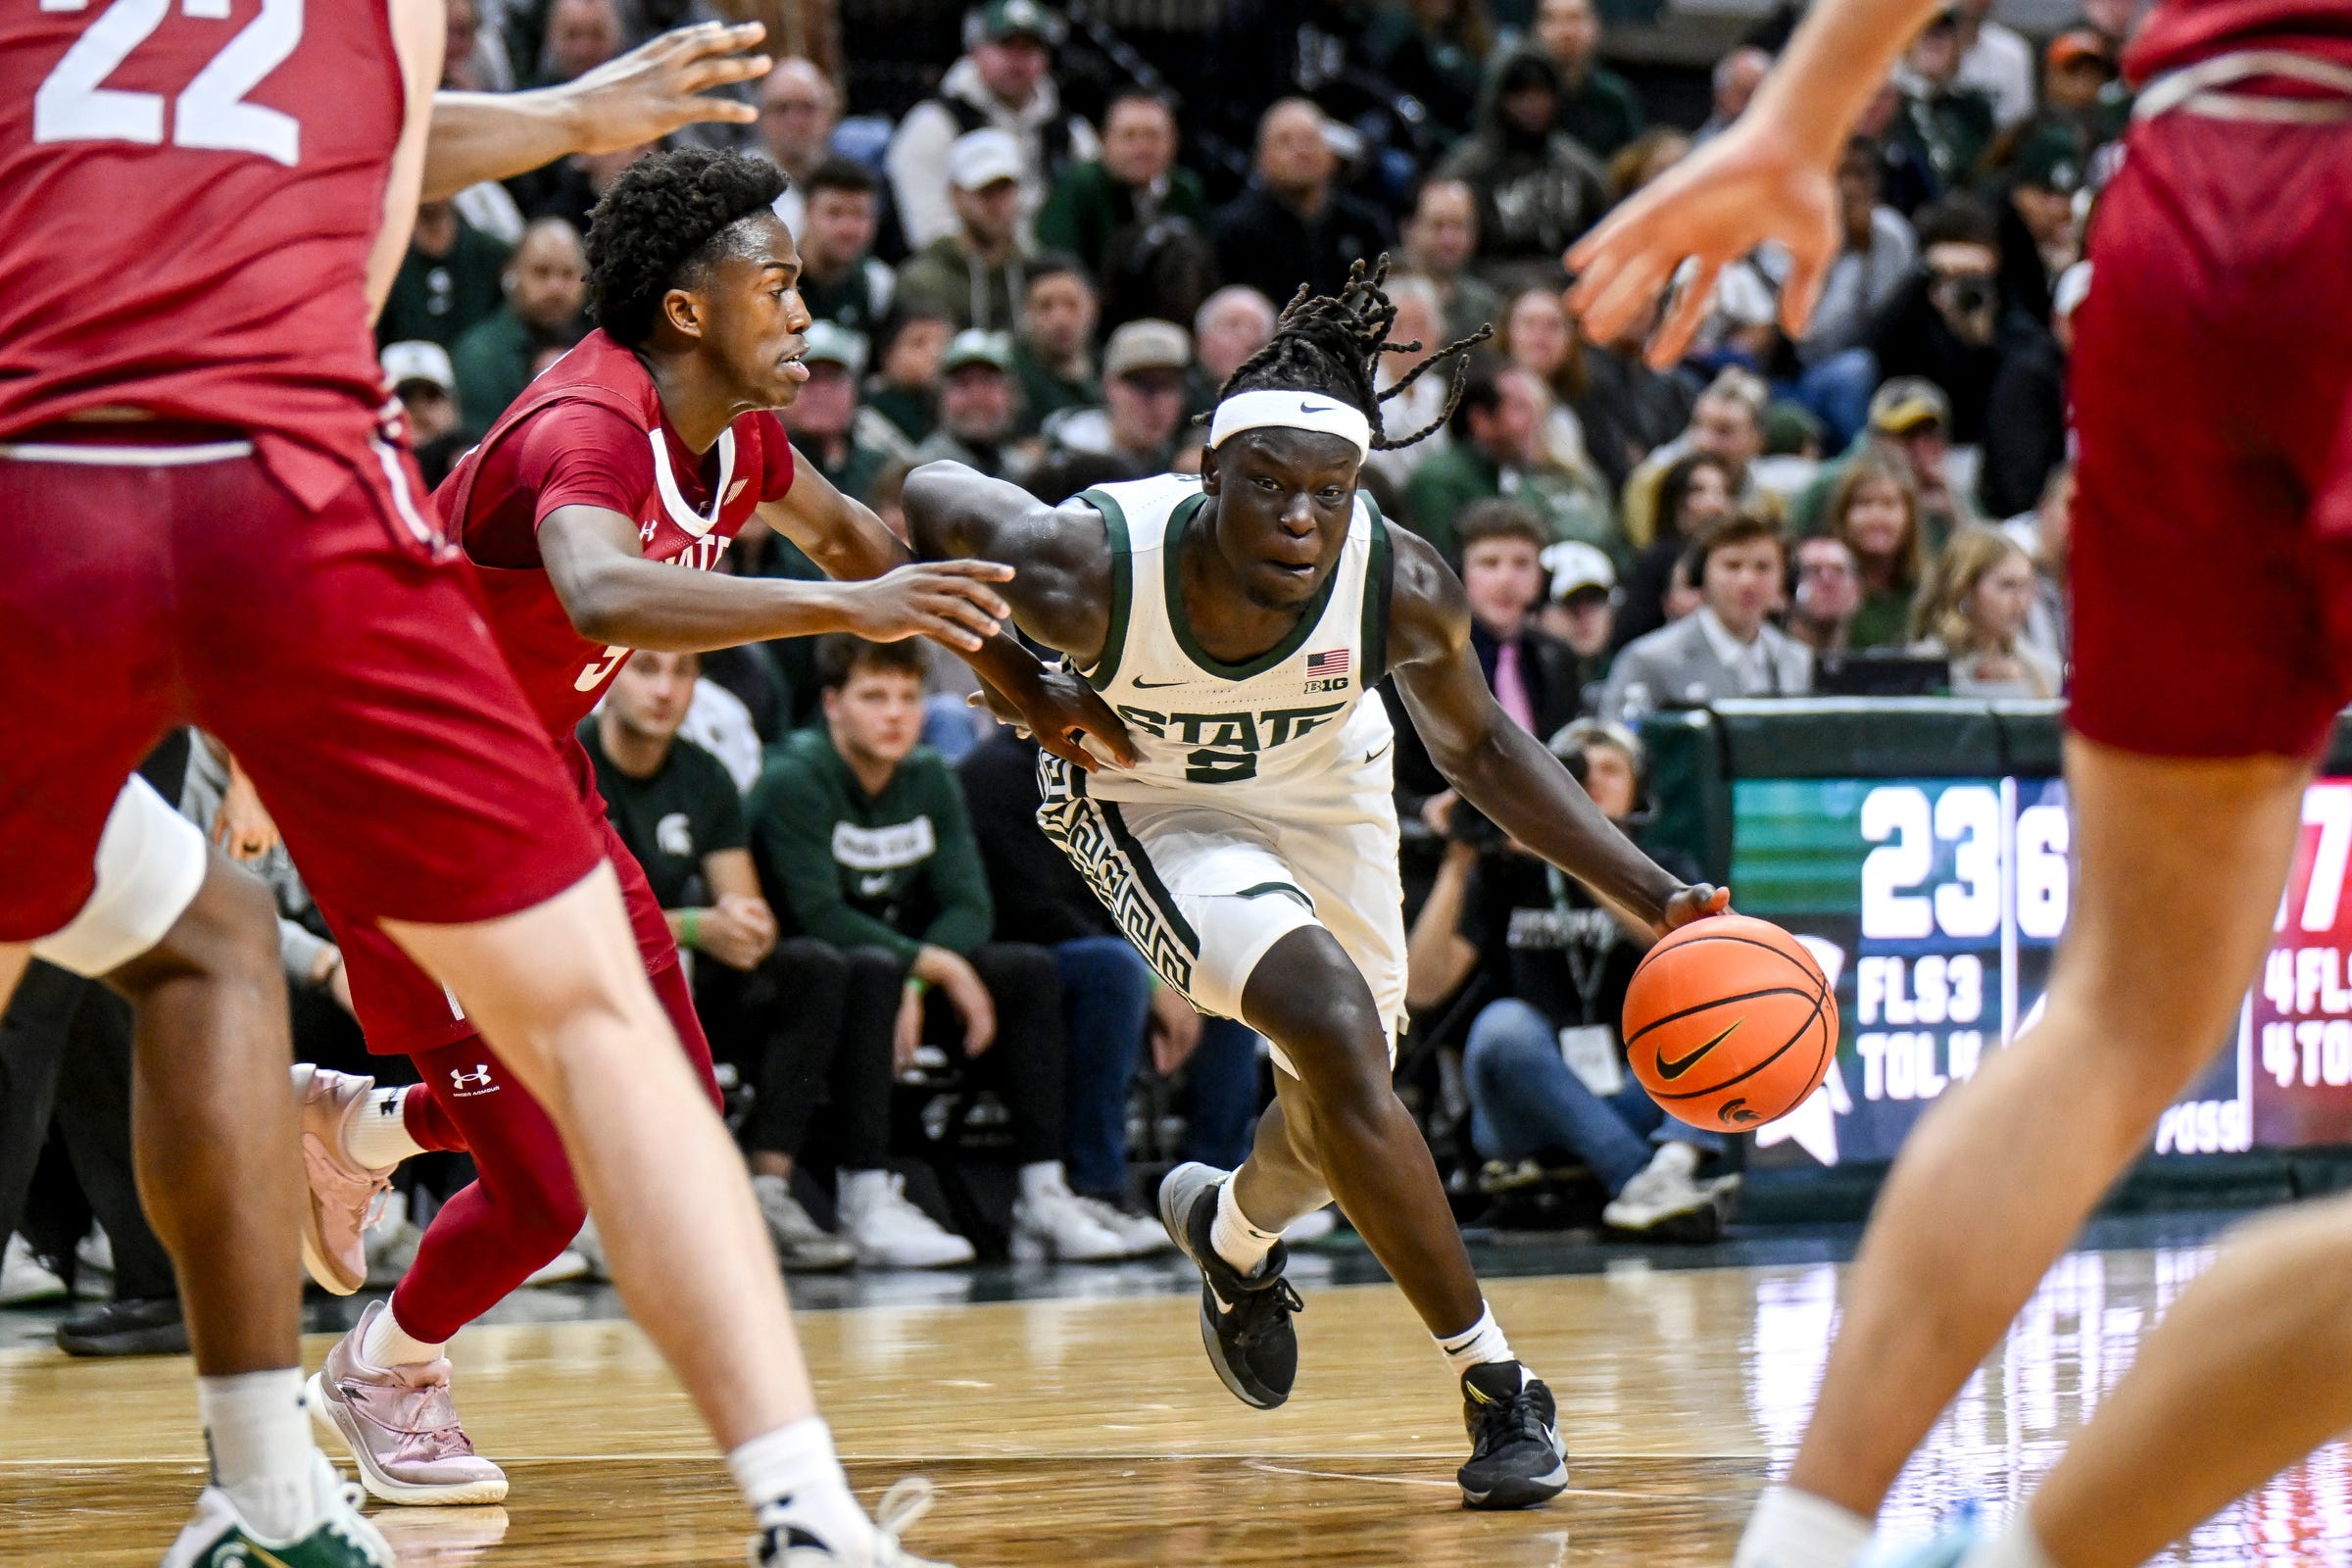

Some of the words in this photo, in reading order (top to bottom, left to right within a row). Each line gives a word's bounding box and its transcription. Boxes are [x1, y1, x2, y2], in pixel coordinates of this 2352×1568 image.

[33, 0, 305, 168] 22
[1116, 700, 1348, 753] STATE
[1860, 785, 2001, 939] 23
